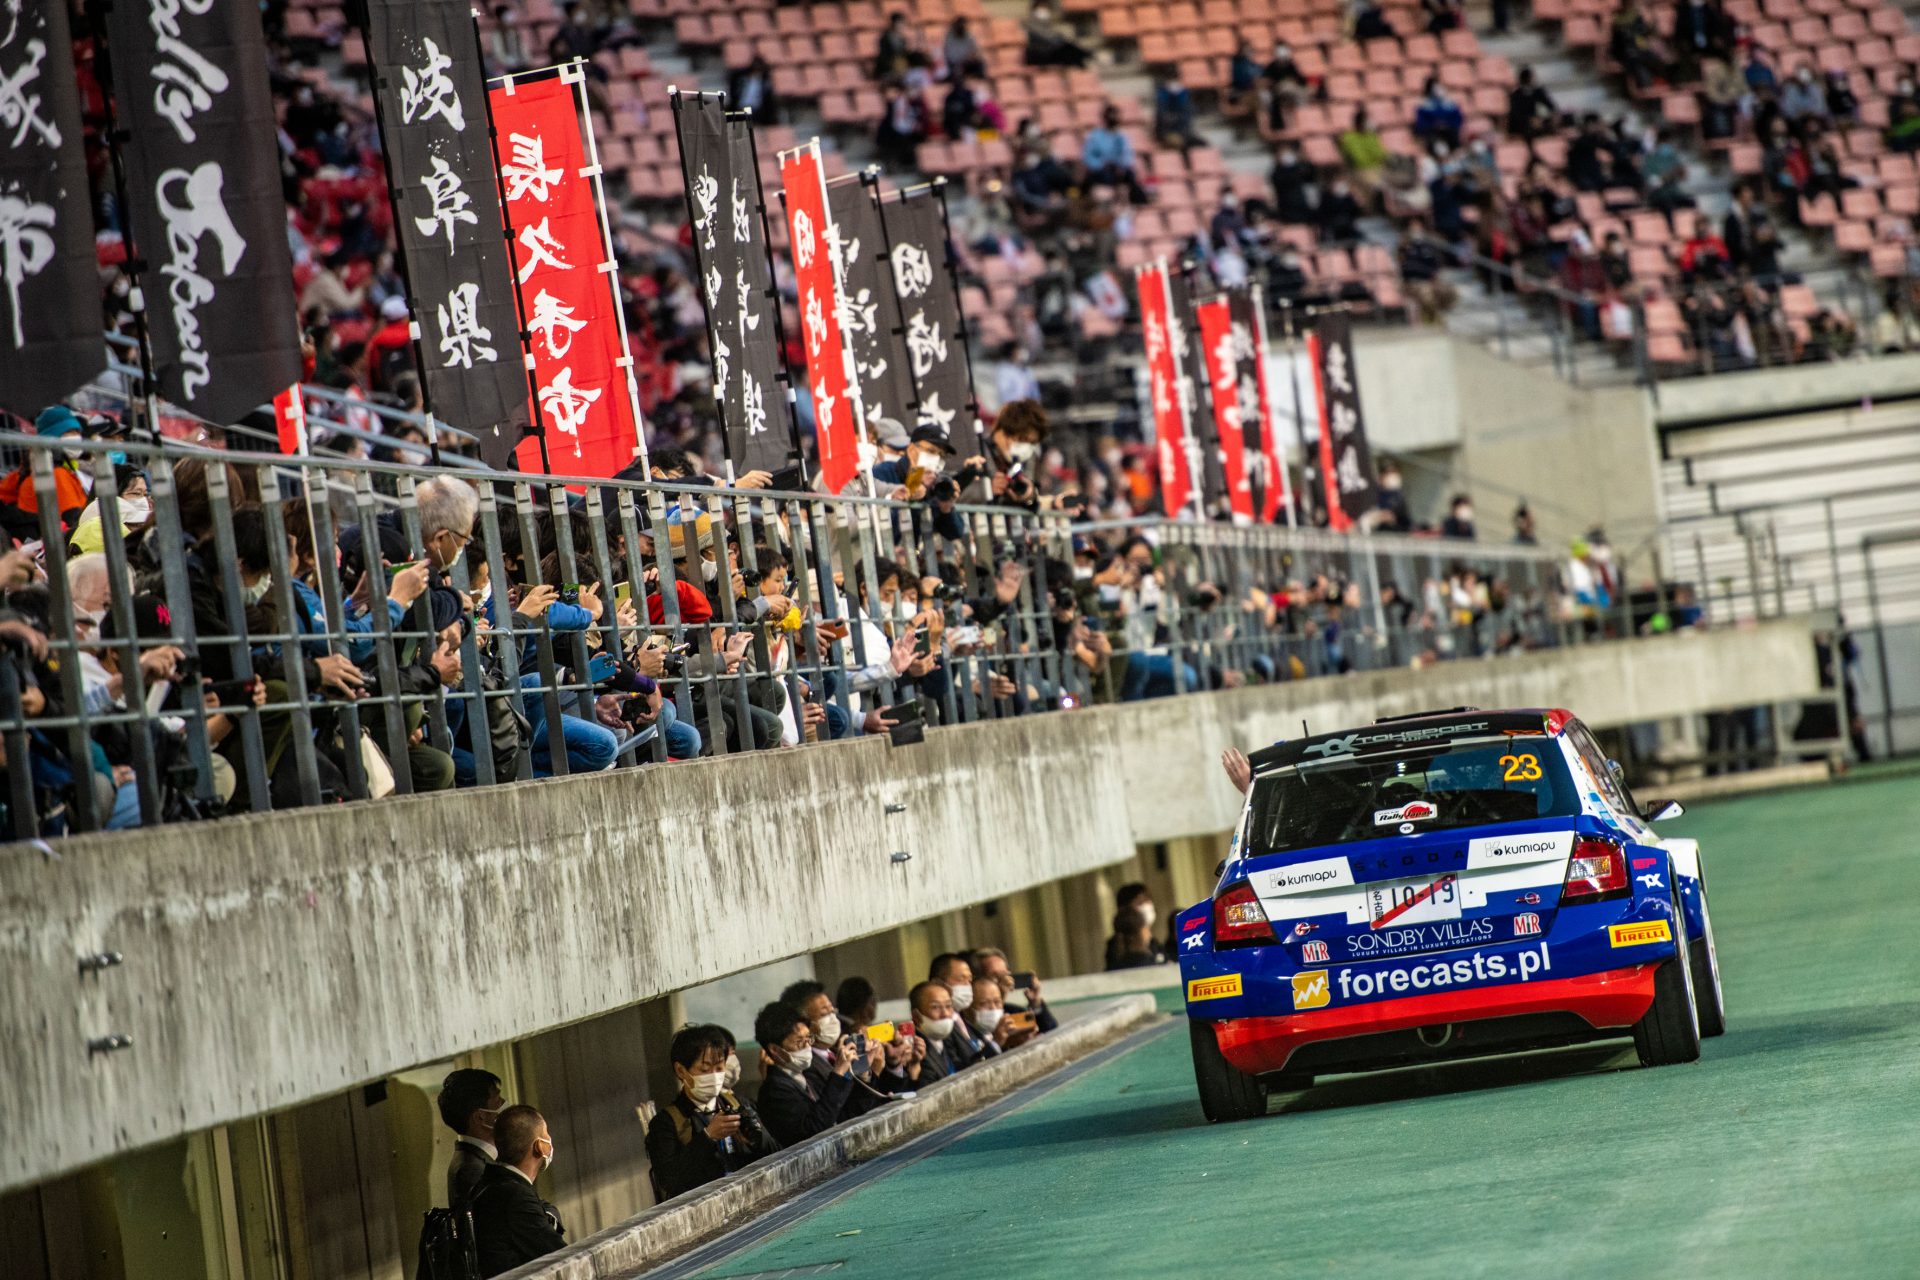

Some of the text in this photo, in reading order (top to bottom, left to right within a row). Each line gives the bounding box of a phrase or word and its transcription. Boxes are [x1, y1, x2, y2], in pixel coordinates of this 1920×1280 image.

[400, 36, 498, 369] 岐阜県
[1499, 753, 1543, 783] 23
[1379, 813, 1404, 822] Rally
[1504, 840, 1556, 857] kumiapu
[1287, 868, 1337, 887] kumiapu
[1346, 917, 1494, 952] SONDBY VILLAS
[1382, 946, 1408, 955] VILLAS
[1421, 941, 1449, 950] LUXURY
[1451, 934, 1493, 945] LOCATIONS
[1616, 926, 1665, 943] PIRELLI
[1338, 941, 1551, 999] forecasts.pl
[1192, 978, 1237, 997] PIRELLI
